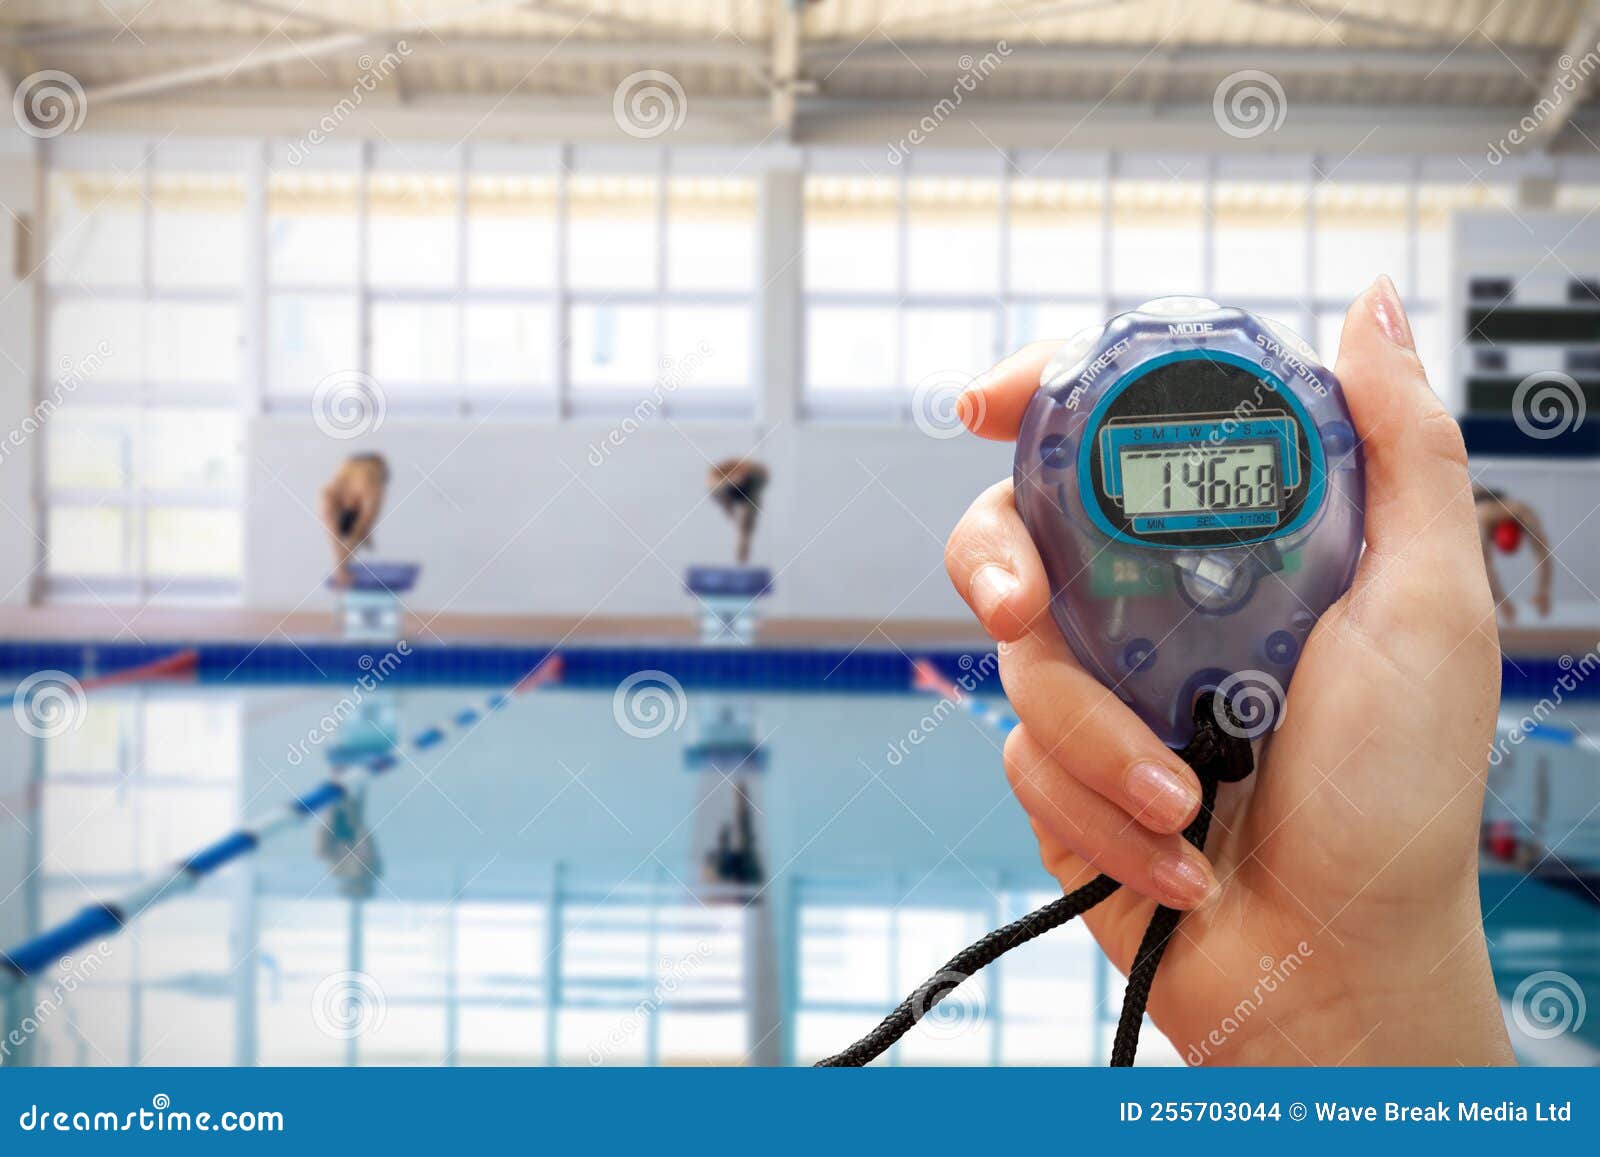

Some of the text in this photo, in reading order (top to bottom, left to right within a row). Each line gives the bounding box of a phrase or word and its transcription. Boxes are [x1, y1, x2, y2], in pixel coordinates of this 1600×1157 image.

[1167, 322, 1213, 336] MODE
[1065, 337, 1129, 412] SPLIT/RESET
[1256, 334, 1328, 397] START/STOP
[1189, 426, 1202, 437] W
